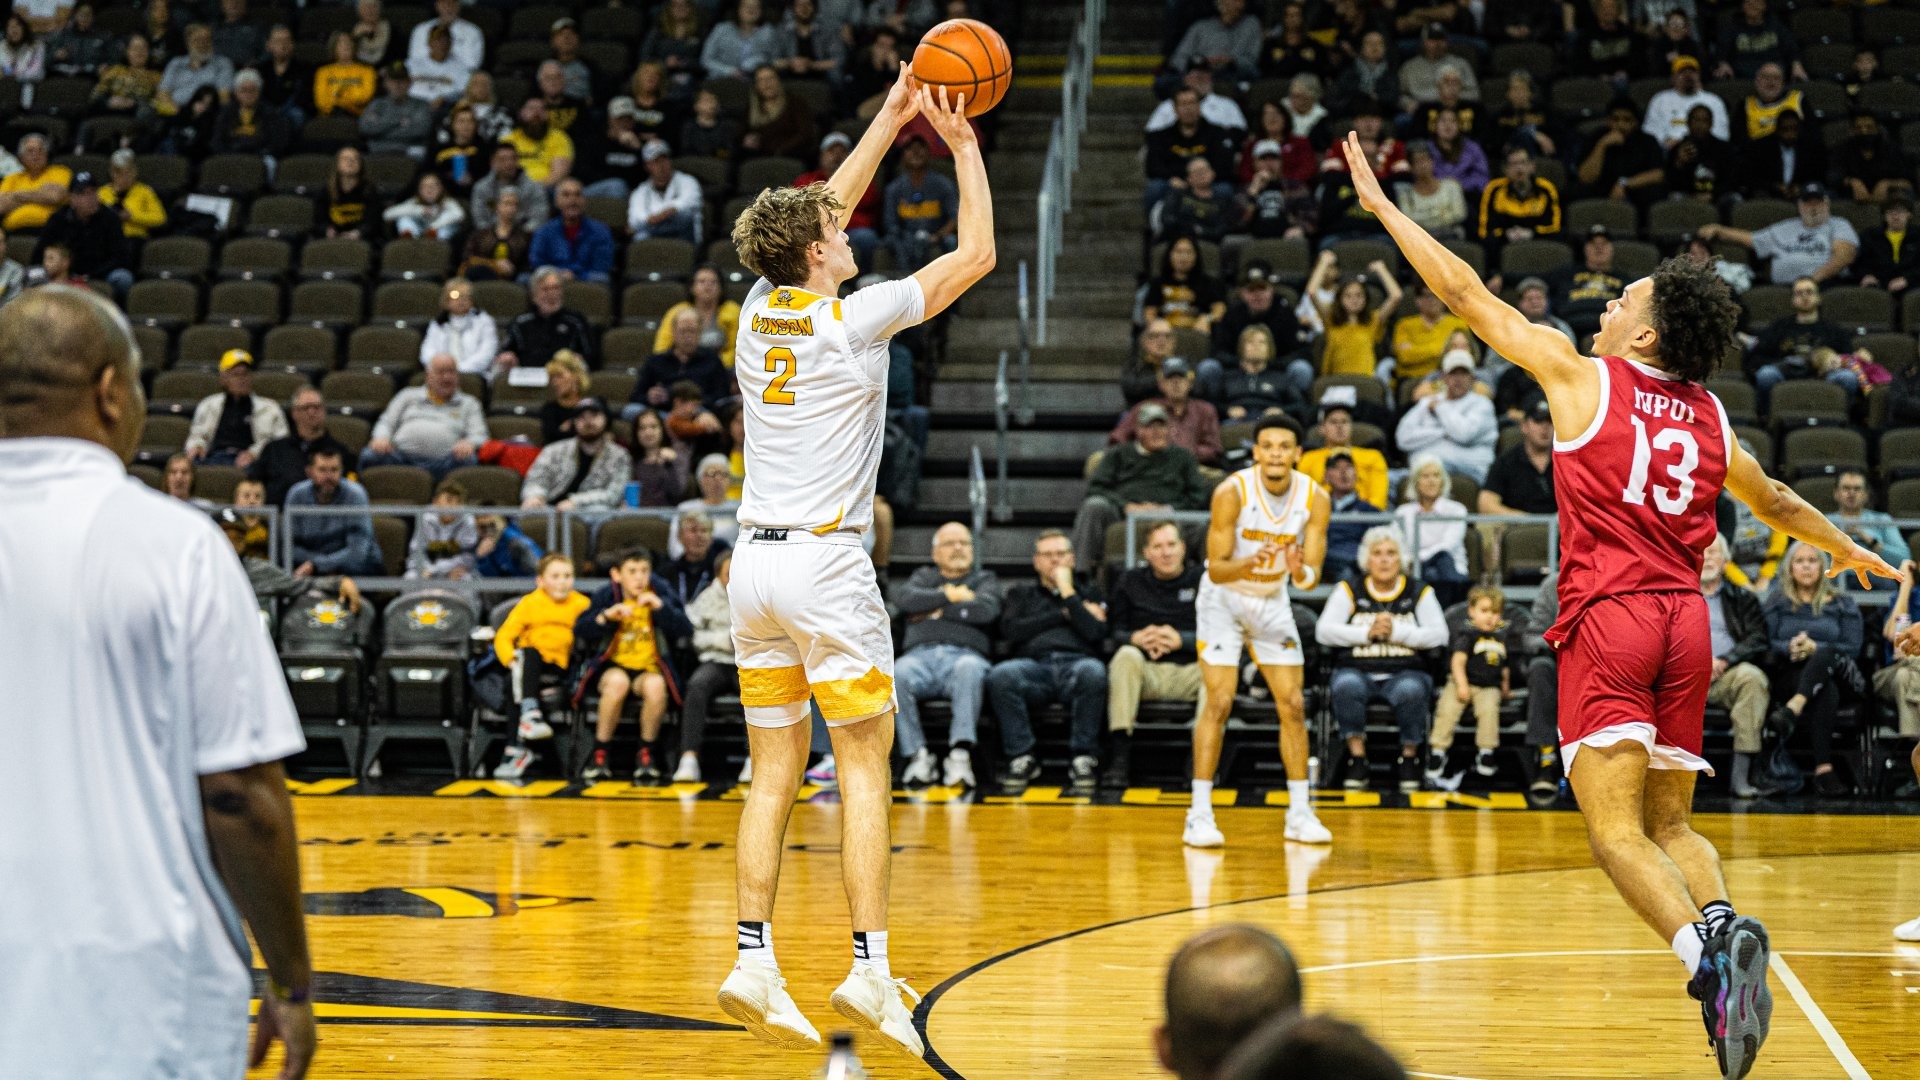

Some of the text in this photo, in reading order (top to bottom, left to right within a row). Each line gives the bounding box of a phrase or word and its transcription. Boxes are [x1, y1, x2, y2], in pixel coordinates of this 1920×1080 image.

[752, 313, 814, 336] VINSON
[763, 346, 797, 405] 2
[1622, 414, 1699, 516] 13
